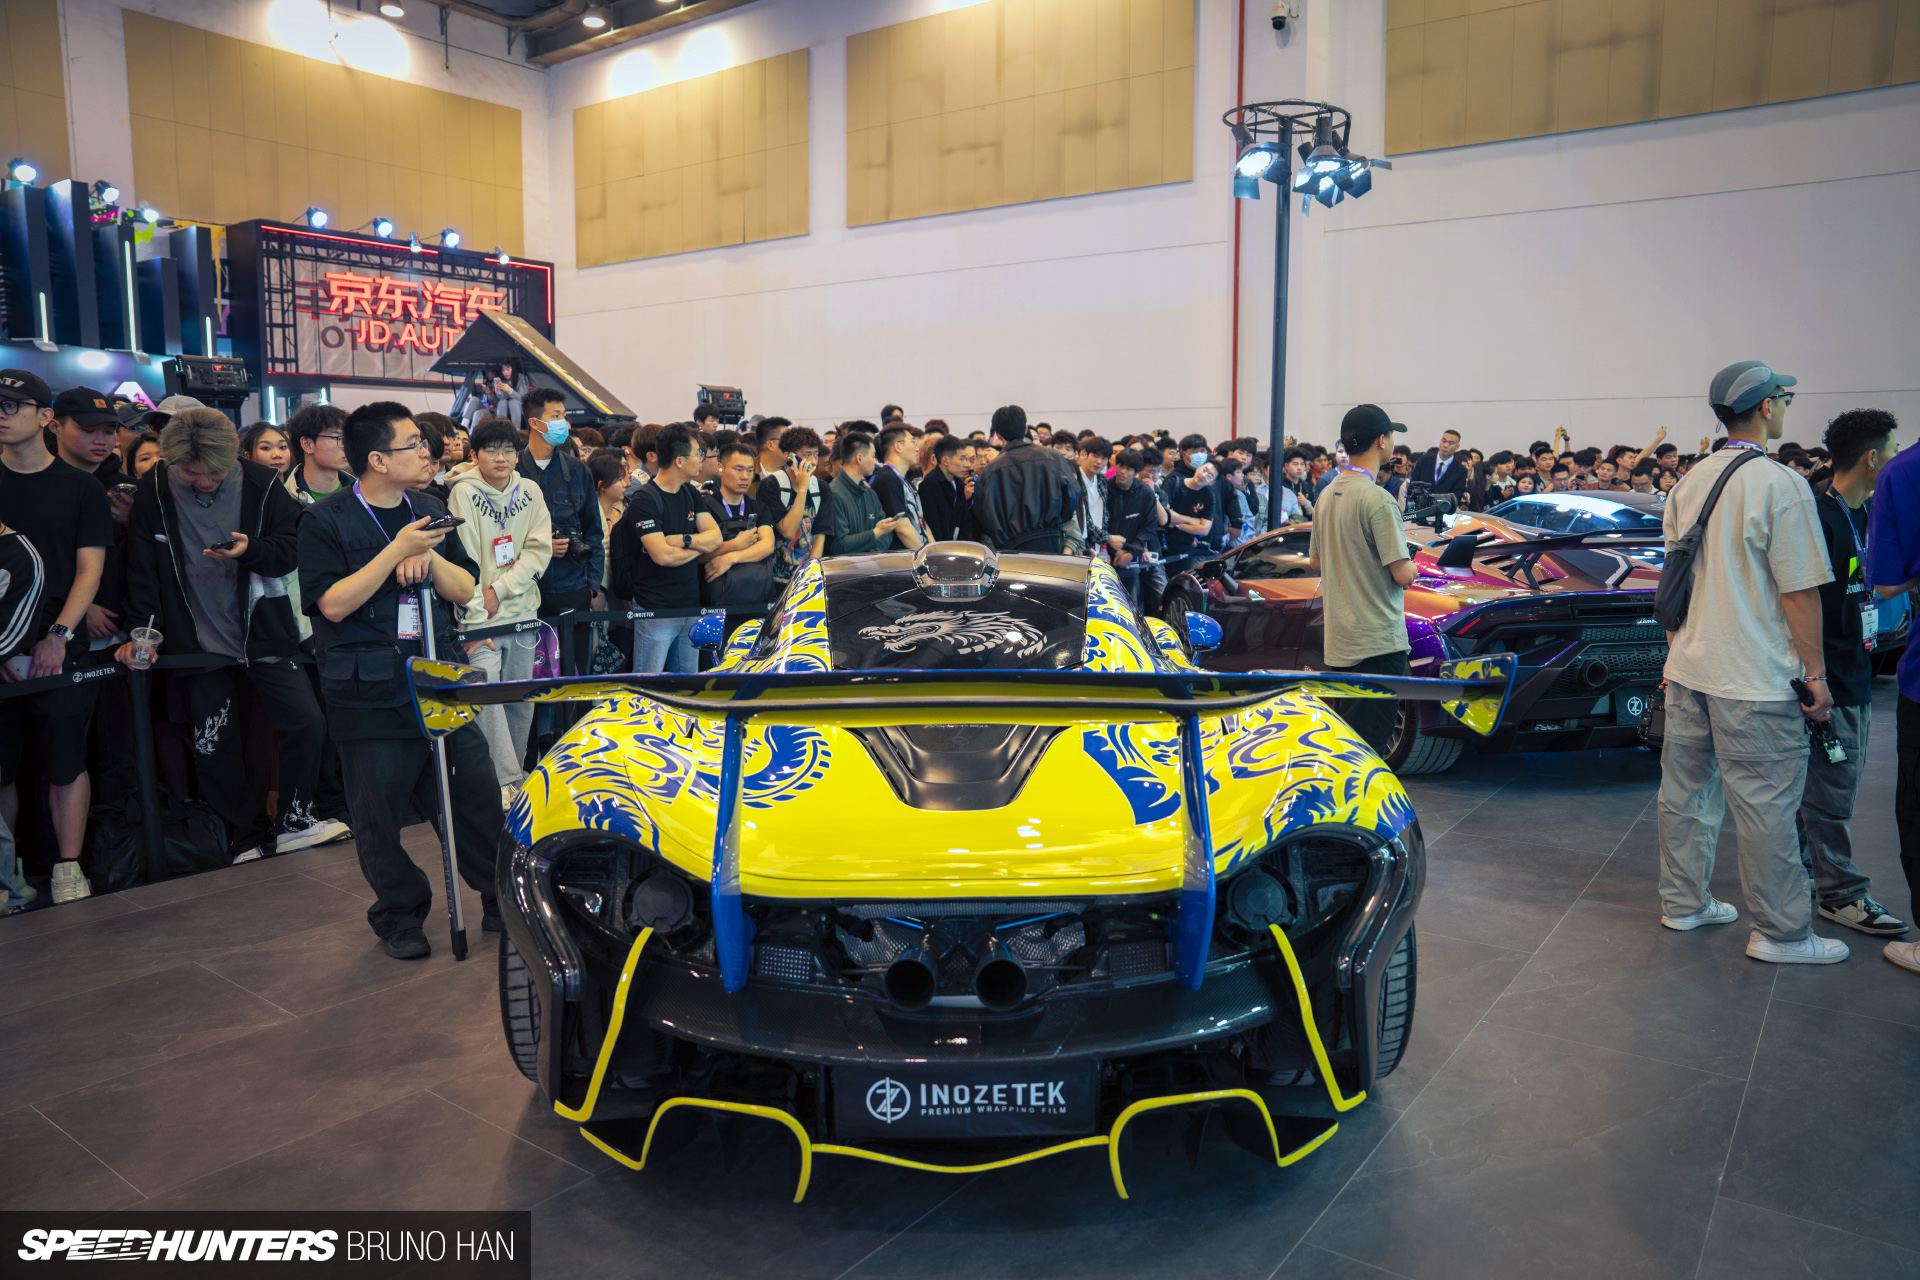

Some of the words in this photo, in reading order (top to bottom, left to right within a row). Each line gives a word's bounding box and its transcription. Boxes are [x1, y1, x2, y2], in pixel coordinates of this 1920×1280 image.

[325, 271, 504, 325] 京东汽车
[356, 319, 391, 344] JD
[399, 323, 461, 350] AUT
[1403, 513, 1417, 521] ONIN
[523, 621, 542, 630] INOZETEK
[84, 667, 115, 678] INOZETEK
[920, 1081, 1066, 1105] INOZETEK
[921, 1106, 971, 1116] PREMIUM
[977, 1105, 1035, 1114] WRAPPING
[1041, 1106, 1067, 1114] FILM
